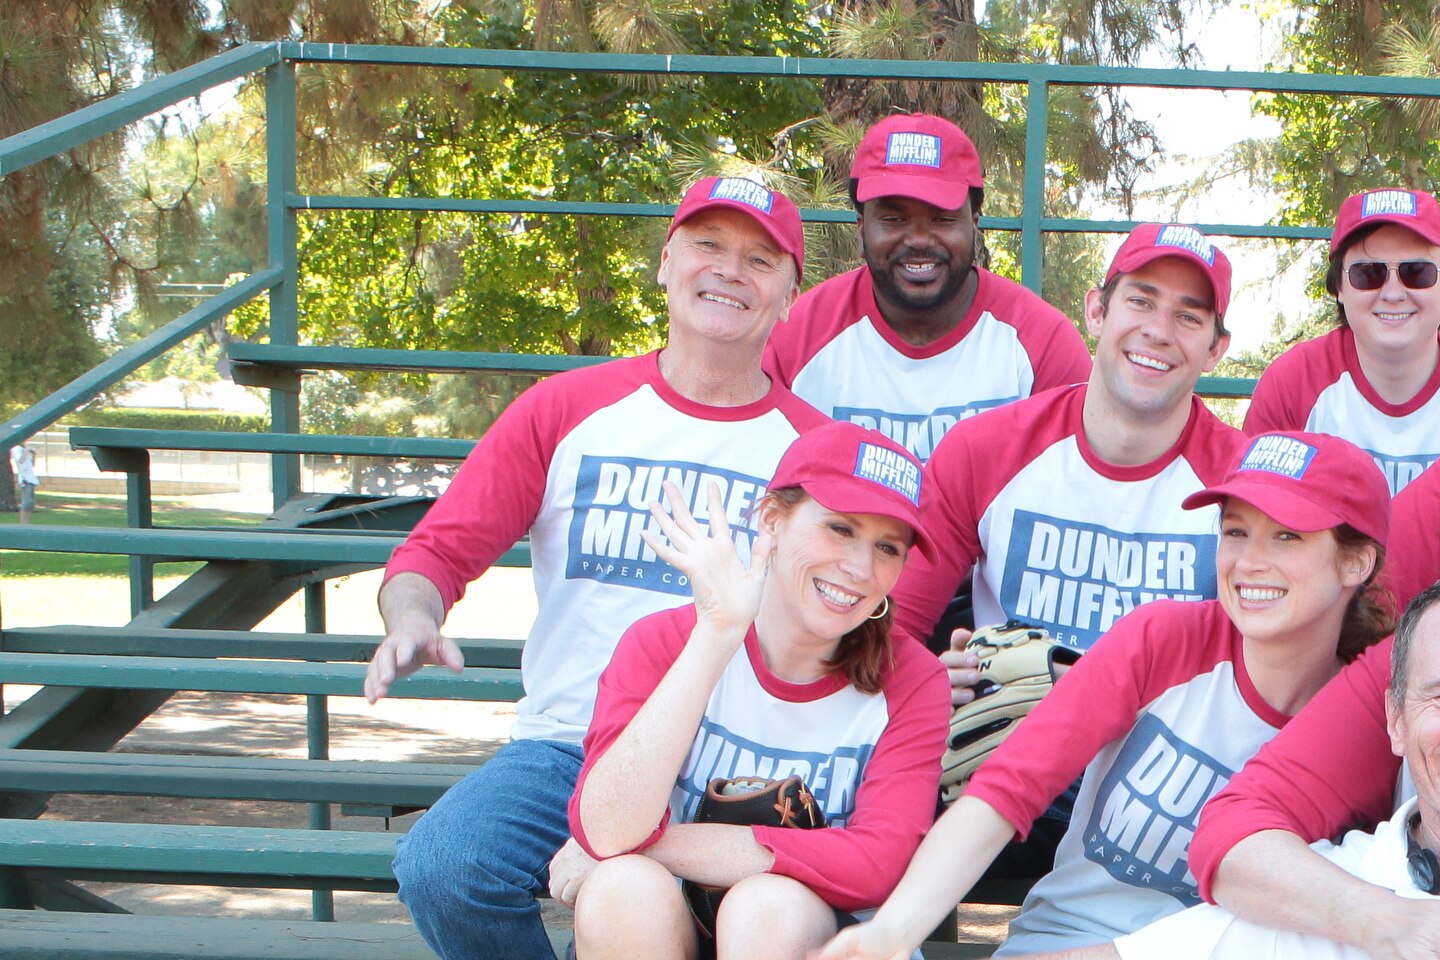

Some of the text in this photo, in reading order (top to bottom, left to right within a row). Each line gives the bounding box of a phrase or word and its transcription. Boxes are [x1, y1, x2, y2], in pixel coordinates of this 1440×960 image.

[892, 133, 935, 149] DUNDER
[890, 145, 932, 161] MIFFLIN
[717, 178, 769, 200] DUNDER
[1368, 191, 1410, 202] DUNDER
[1163, 226, 1210, 250] DUNDER
[1253, 435, 1309, 459] DUNDER
[864, 444, 918, 482] DUNDER
[1244, 449, 1299, 472] MIFFLIN
[861, 457, 914, 495] MIFFLIN
[1027, 521, 1197, 591] DUNDER
[582, 561, 645, 579] PAPER
[1089, 834, 1152, 884] PAPER
